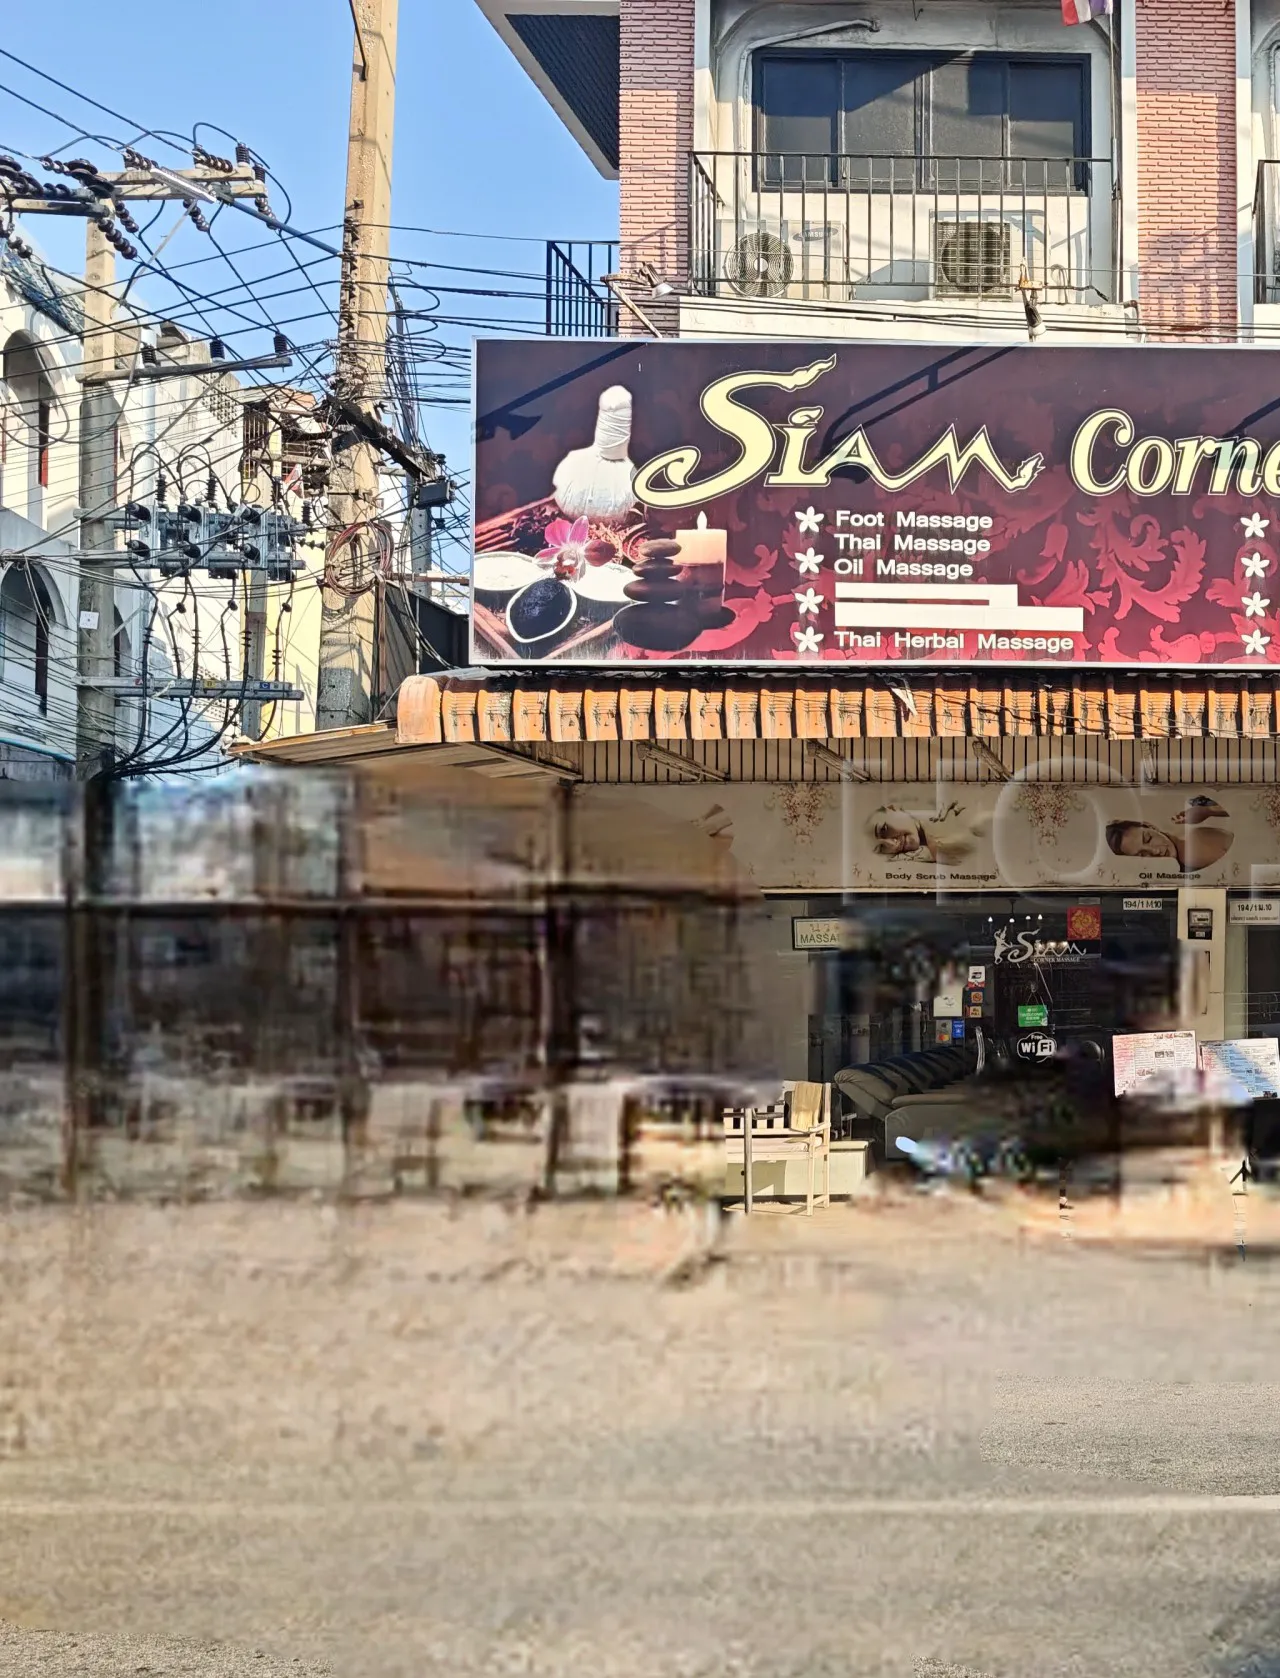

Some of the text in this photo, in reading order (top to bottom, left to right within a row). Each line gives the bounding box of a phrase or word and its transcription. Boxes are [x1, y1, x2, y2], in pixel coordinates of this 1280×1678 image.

[799, 230, 834, 239] SAMSU
[835, 510, 993, 531] Foot Massage
[834, 533, 991, 554] Thai Massage
[834, 558, 973, 579] Oil Massage
[834, 630, 1074, 653] Thai Herbal Massage
[885, 872, 911, 880] Body
[949, 873, 997, 881] Massage
[1156, 872, 1201, 880] Massage
